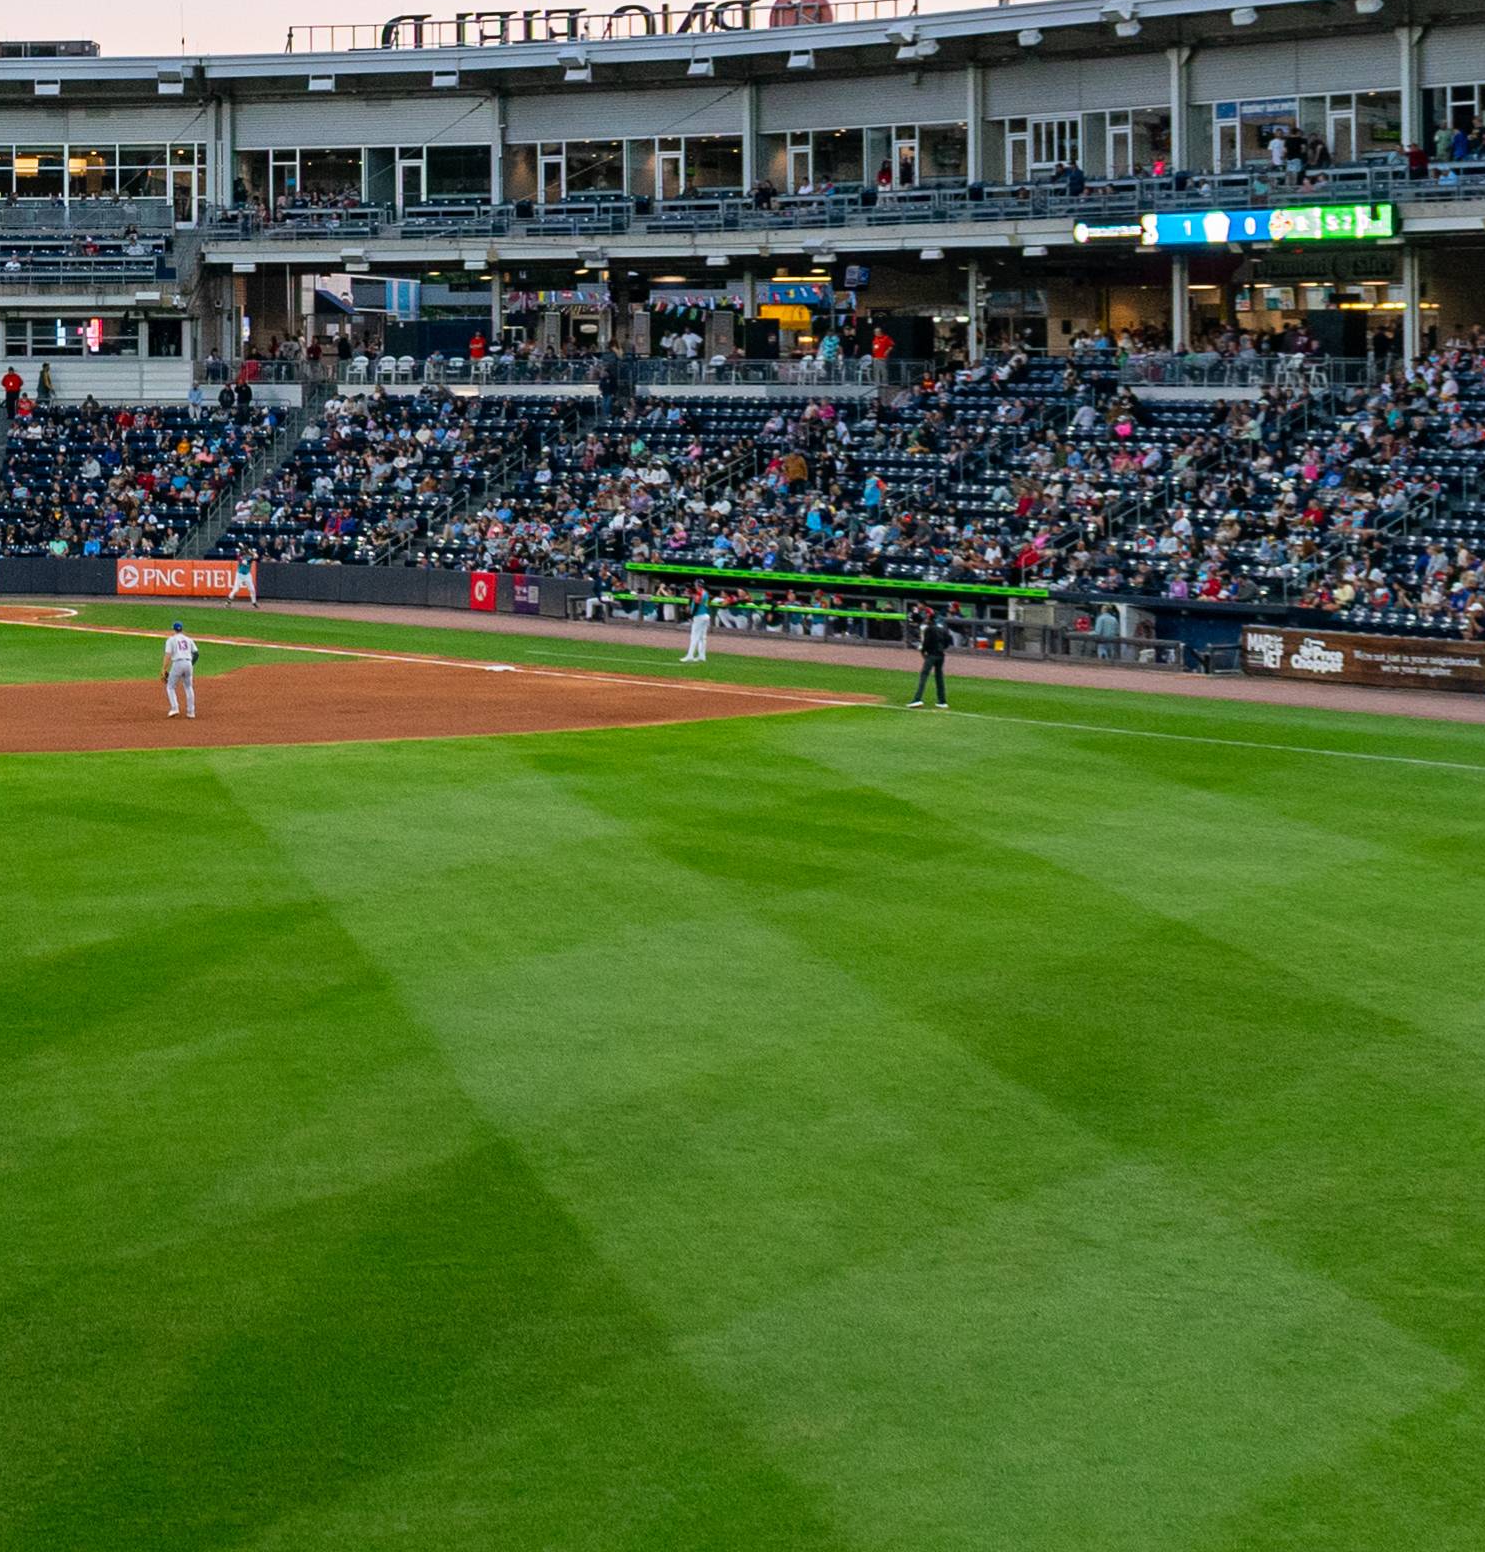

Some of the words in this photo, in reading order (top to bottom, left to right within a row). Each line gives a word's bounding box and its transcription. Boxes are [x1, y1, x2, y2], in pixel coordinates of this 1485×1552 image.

[1244, 217, 1256, 235] 0
[143, 568, 185, 587] PNC
[177, 640, 189, 651] 13
